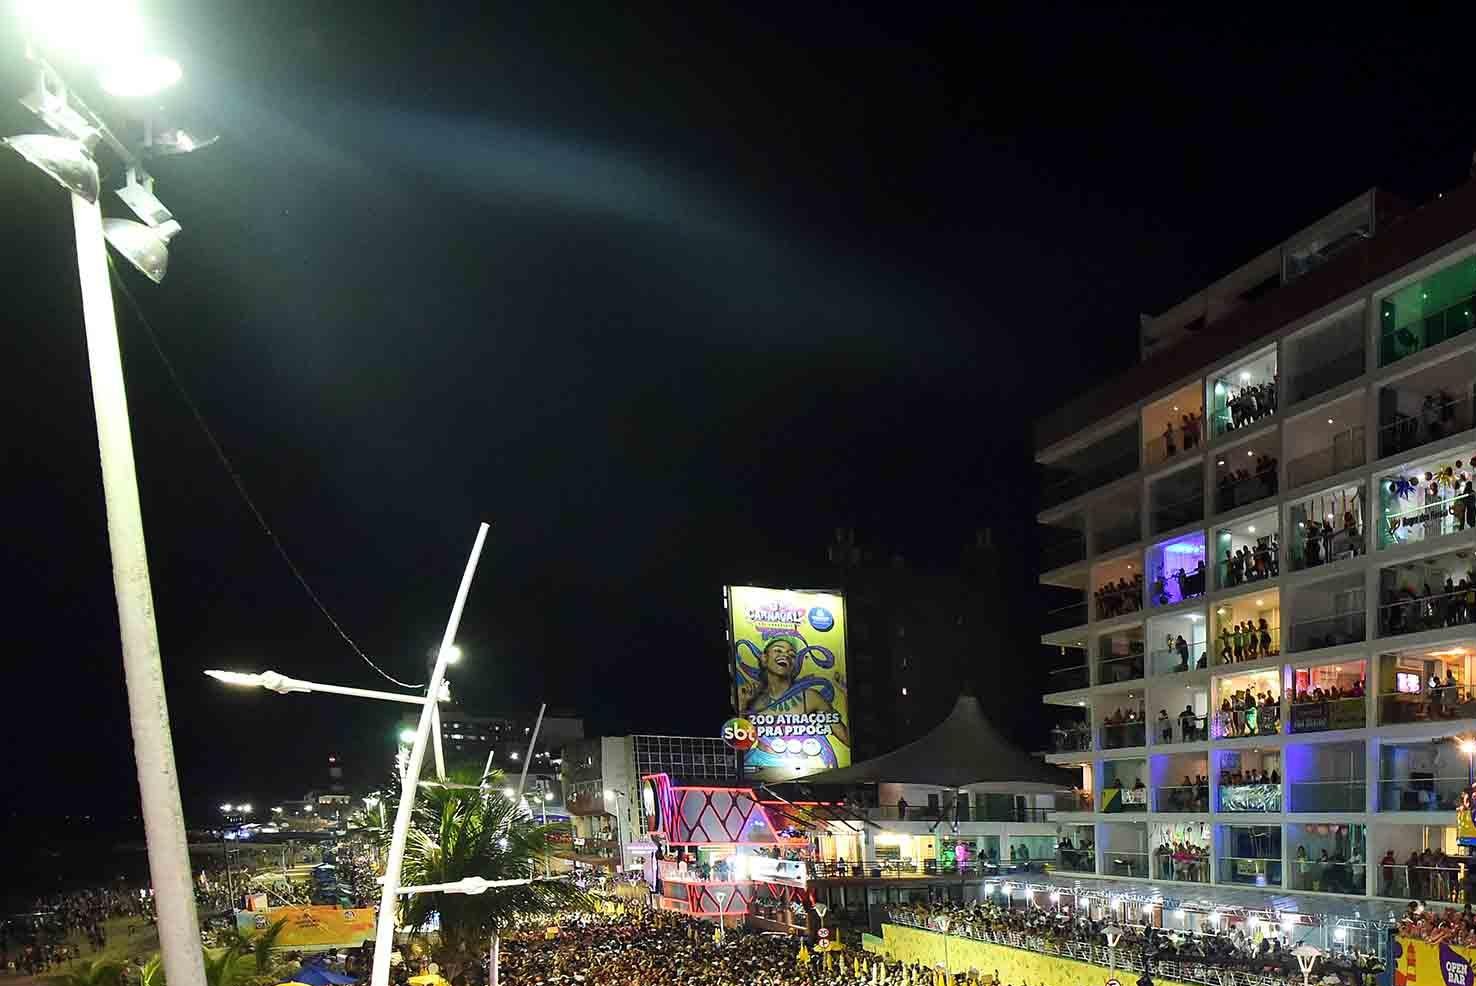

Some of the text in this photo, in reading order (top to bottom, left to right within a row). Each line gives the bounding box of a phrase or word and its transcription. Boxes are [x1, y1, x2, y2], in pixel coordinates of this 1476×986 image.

[750, 712, 840, 728] 200 ATRAÇÕES
[724, 721, 756, 741] sbt
[758, 726, 784, 738] PRA
[1446, 960, 1468, 976] OPEN
[1448, 971, 1466, 986] BAR
